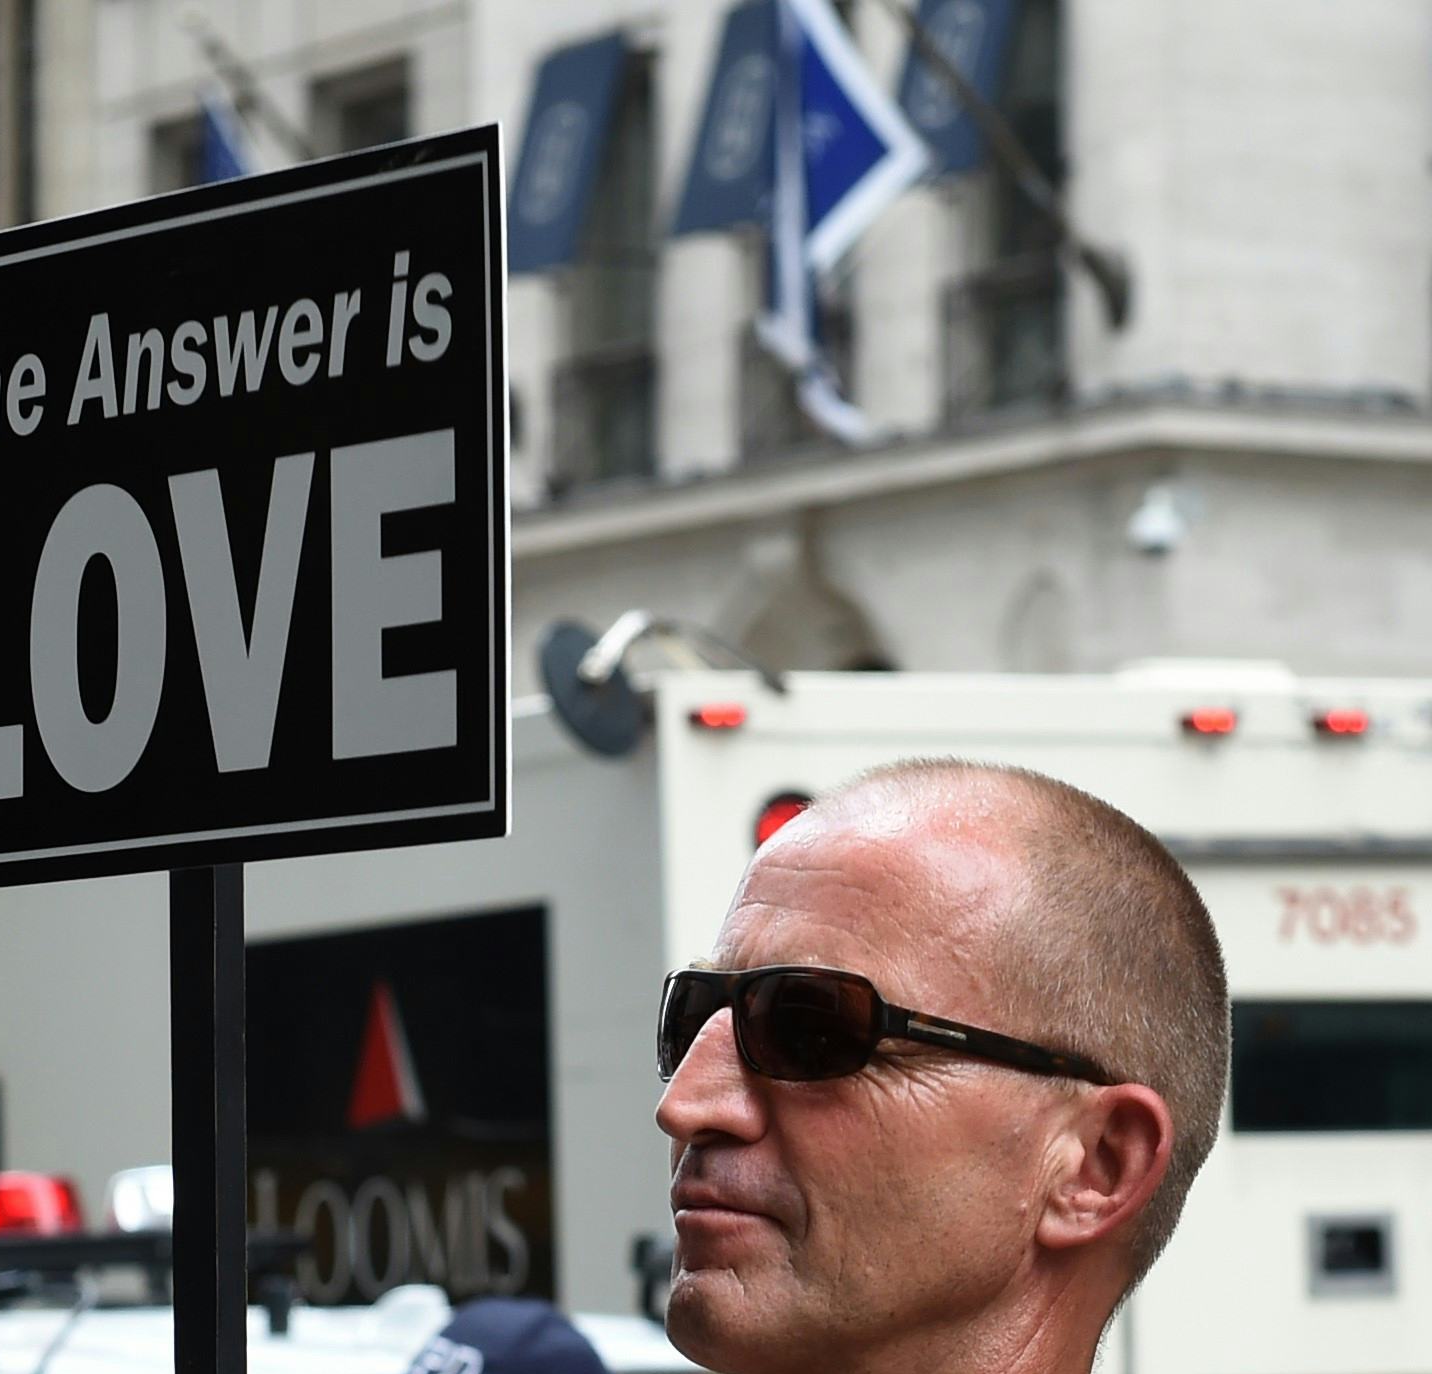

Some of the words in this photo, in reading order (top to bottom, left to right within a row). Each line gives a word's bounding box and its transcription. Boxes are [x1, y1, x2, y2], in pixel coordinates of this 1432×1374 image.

[66, 288, 362, 426] Answer
[386, 250, 454, 368] is
[1273, 884, 1421, 946] 7085
